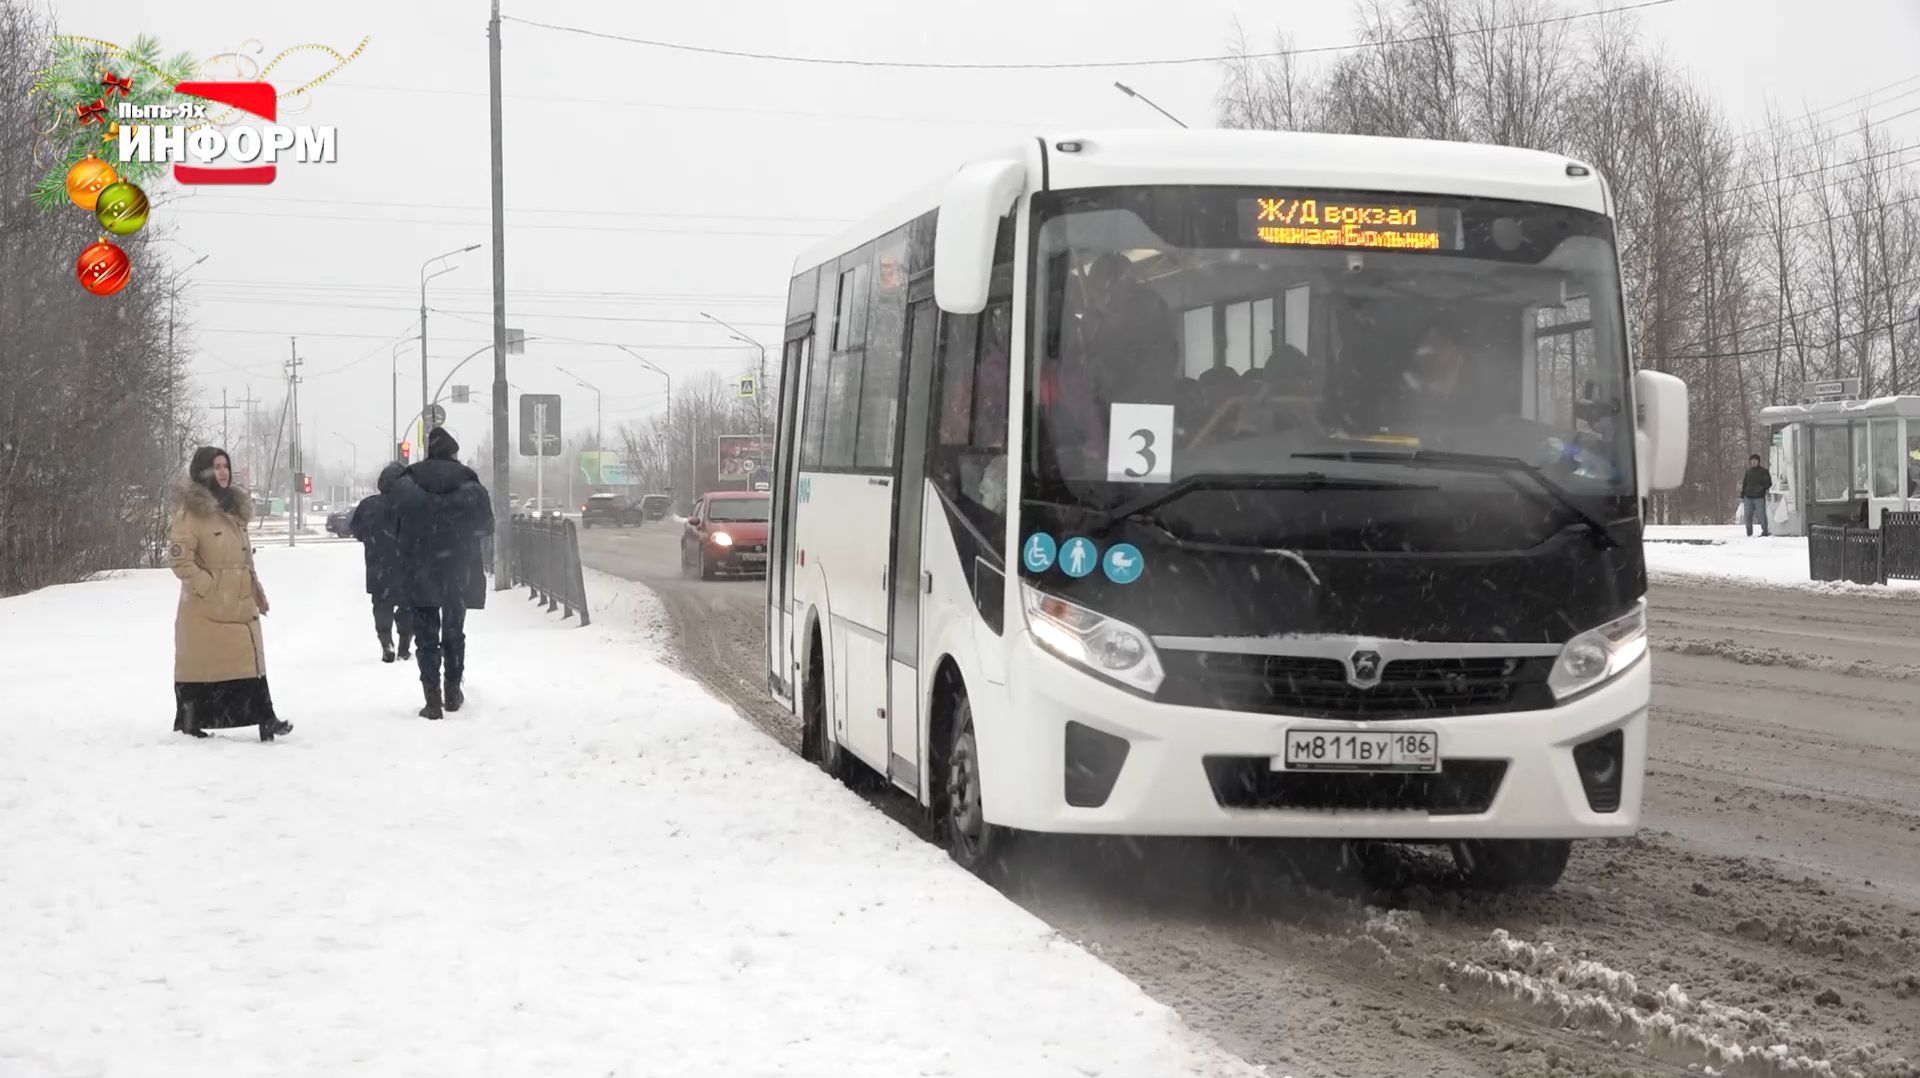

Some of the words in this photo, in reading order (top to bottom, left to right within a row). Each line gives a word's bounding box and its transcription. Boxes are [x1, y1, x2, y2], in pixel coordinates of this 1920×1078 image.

[1257, 198, 1319, 224] Ж/Д
[1324, 206, 1417, 226] вокзал
[1124, 428, 1157, 478] 3
[1395, 735, 1432, 753] 186
